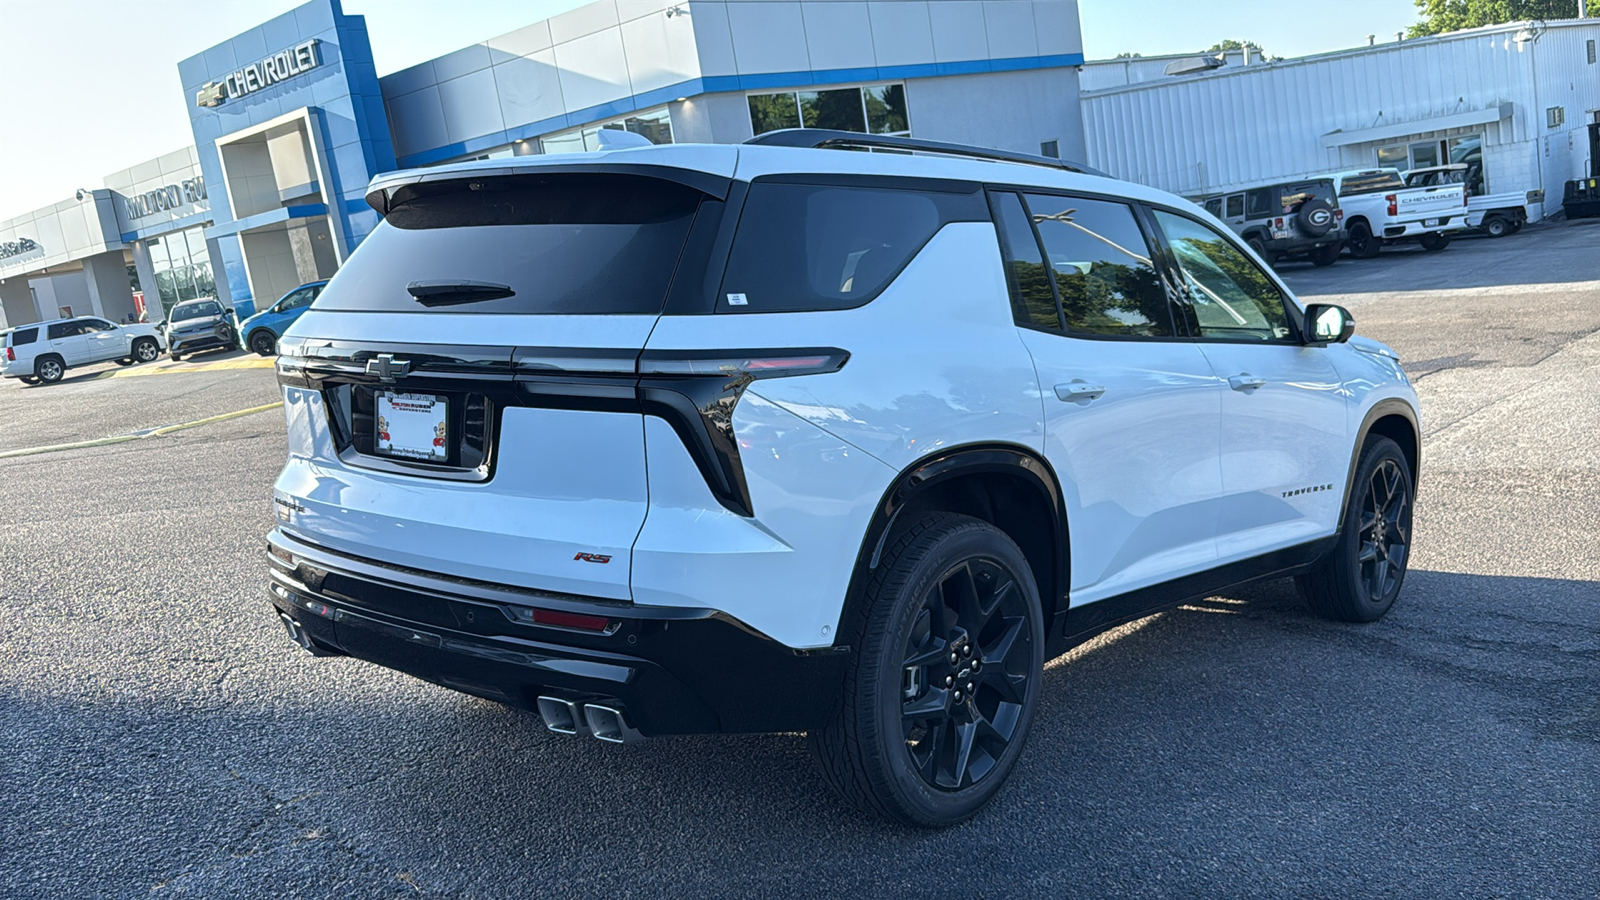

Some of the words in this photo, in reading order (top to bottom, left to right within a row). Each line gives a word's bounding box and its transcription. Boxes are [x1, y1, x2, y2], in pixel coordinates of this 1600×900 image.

[225, 38, 318, 99] CHEVROLET
[124, 184, 180, 220] MILTON
[1402, 192, 1460, 204] CHEVROLET
[1282, 484, 1333, 498] TRAVERSE
[573, 552, 613, 564] RS
